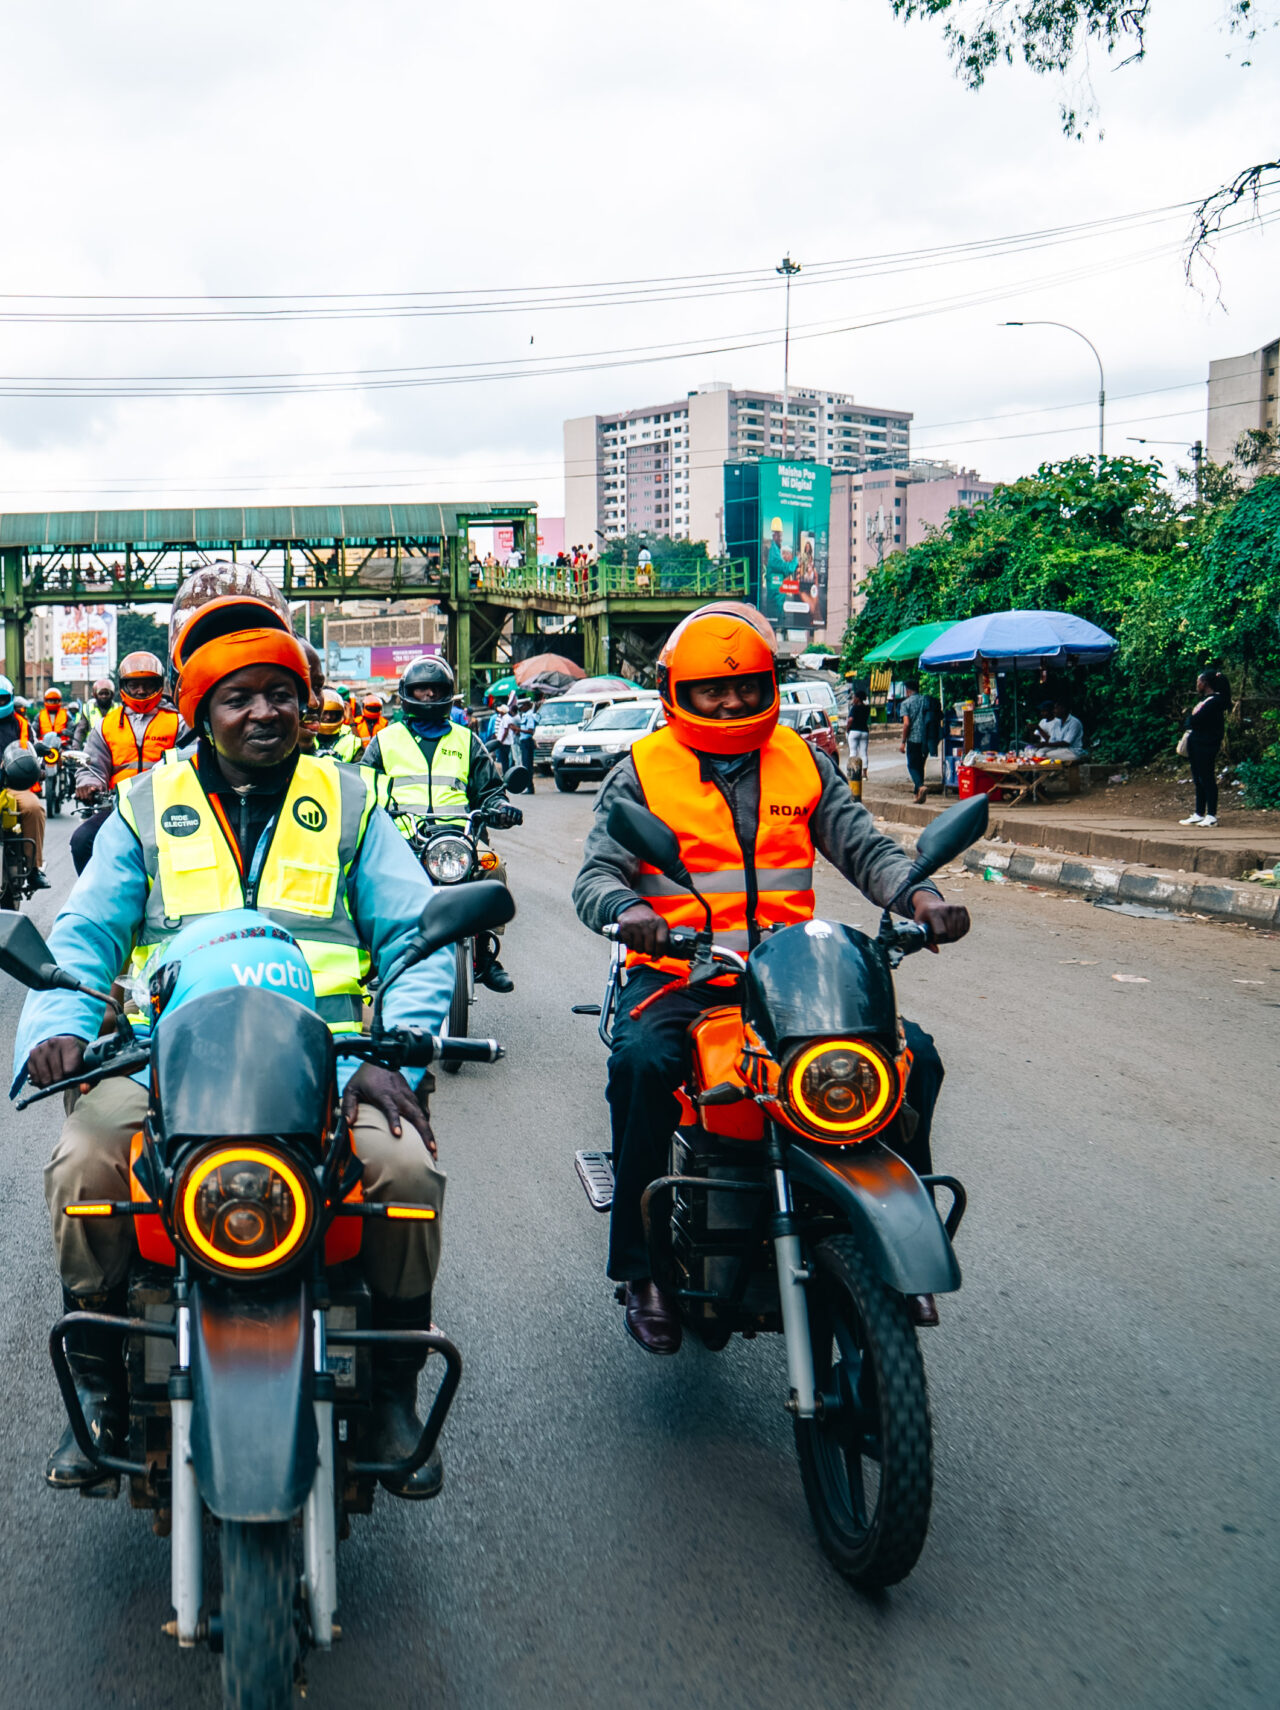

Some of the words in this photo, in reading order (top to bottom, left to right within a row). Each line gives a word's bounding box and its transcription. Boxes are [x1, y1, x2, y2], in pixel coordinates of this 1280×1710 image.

[778, 464, 802, 478] Maisha
[781, 477, 789, 487] Ni
[790, 478, 812, 492] Digital
[163, 819, 199, 828] ELECTRIC
[231, 960, 310, 992] watu
